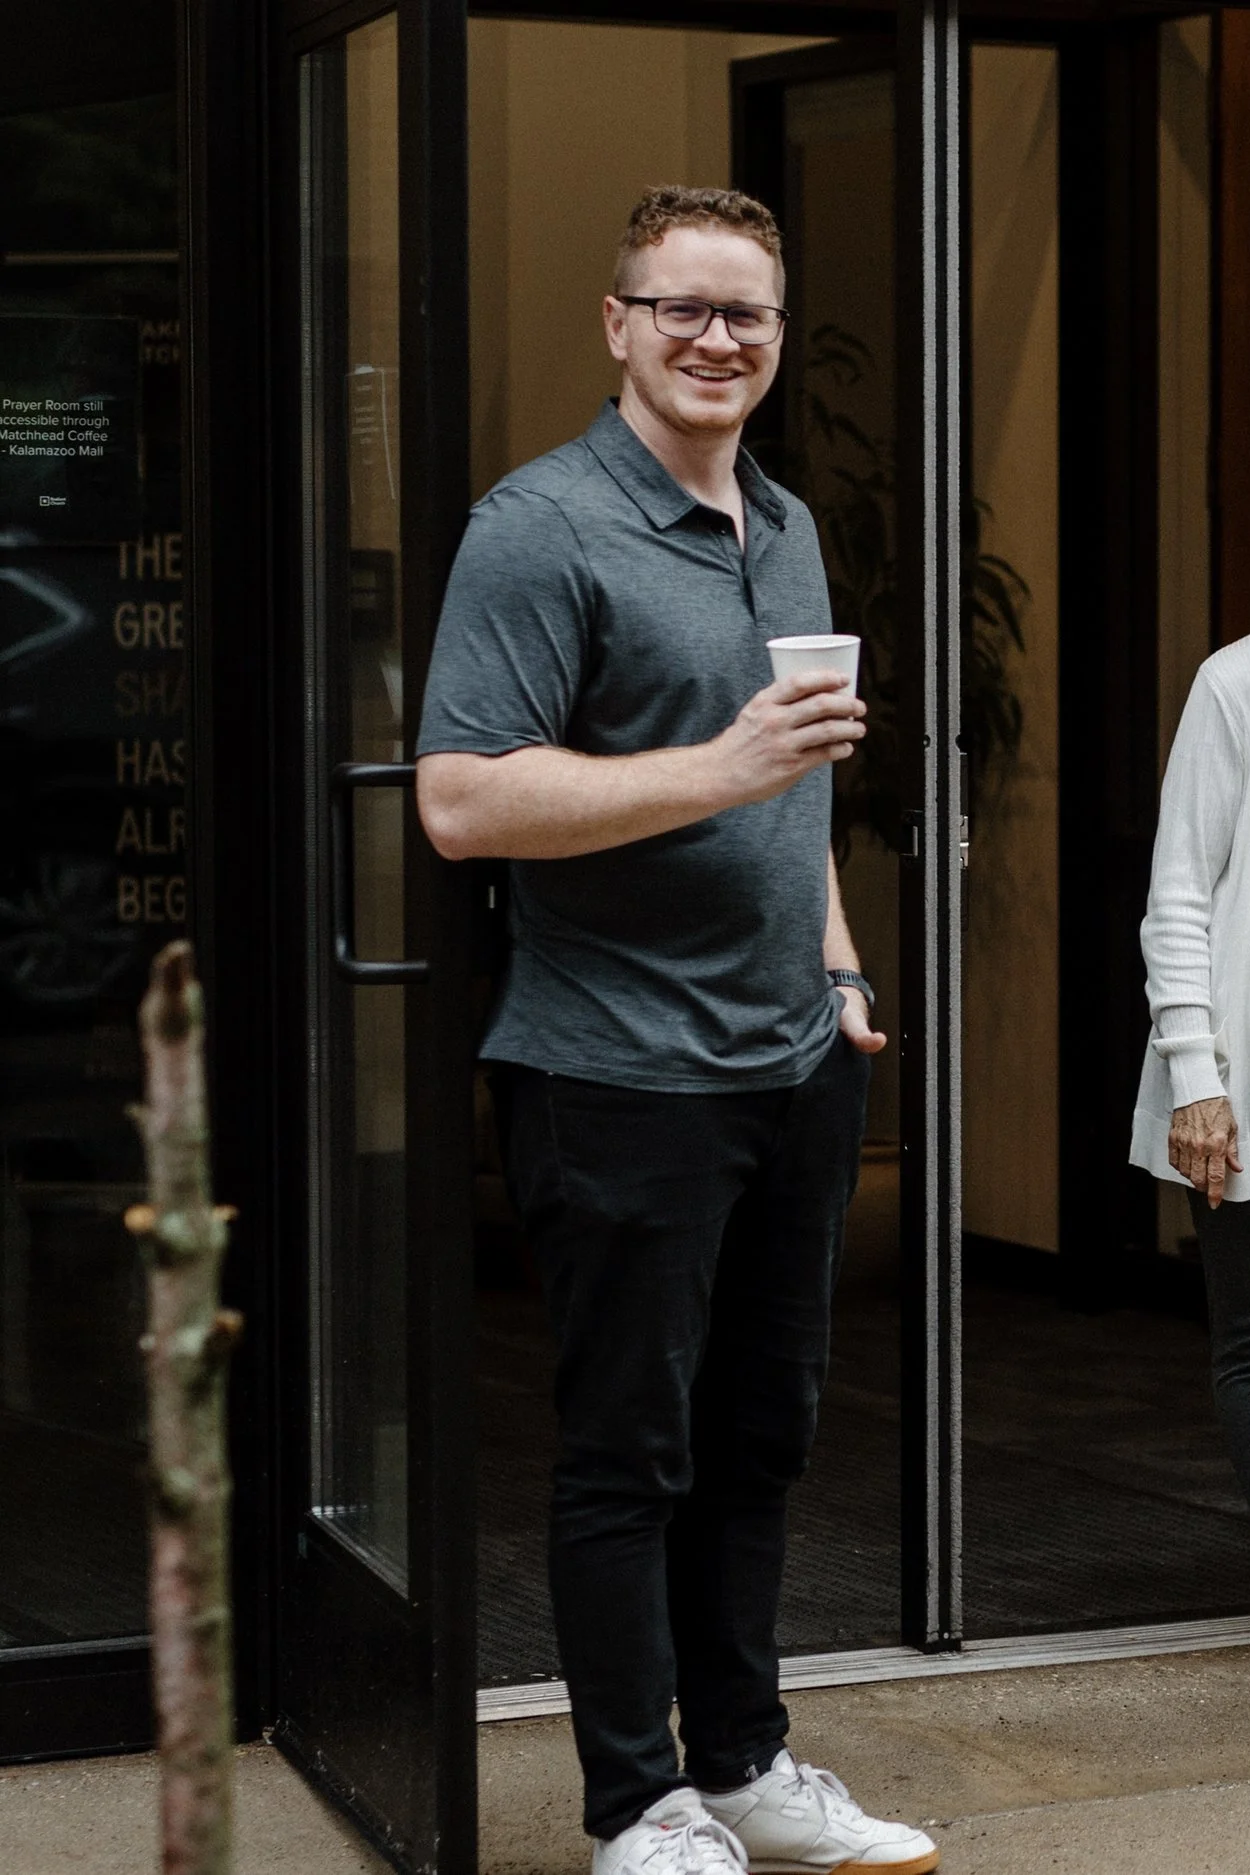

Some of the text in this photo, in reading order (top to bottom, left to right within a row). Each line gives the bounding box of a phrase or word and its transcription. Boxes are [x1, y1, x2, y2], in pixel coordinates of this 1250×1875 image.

[2, 399, 104, 413] Prayer Room still
[62, 416, 110, 429] through
[0, 430, 108, 442] Matchhead Coffee
[9, 445, 76, 456] Kalamazoo
[79, 445, 104, 456] Mall
